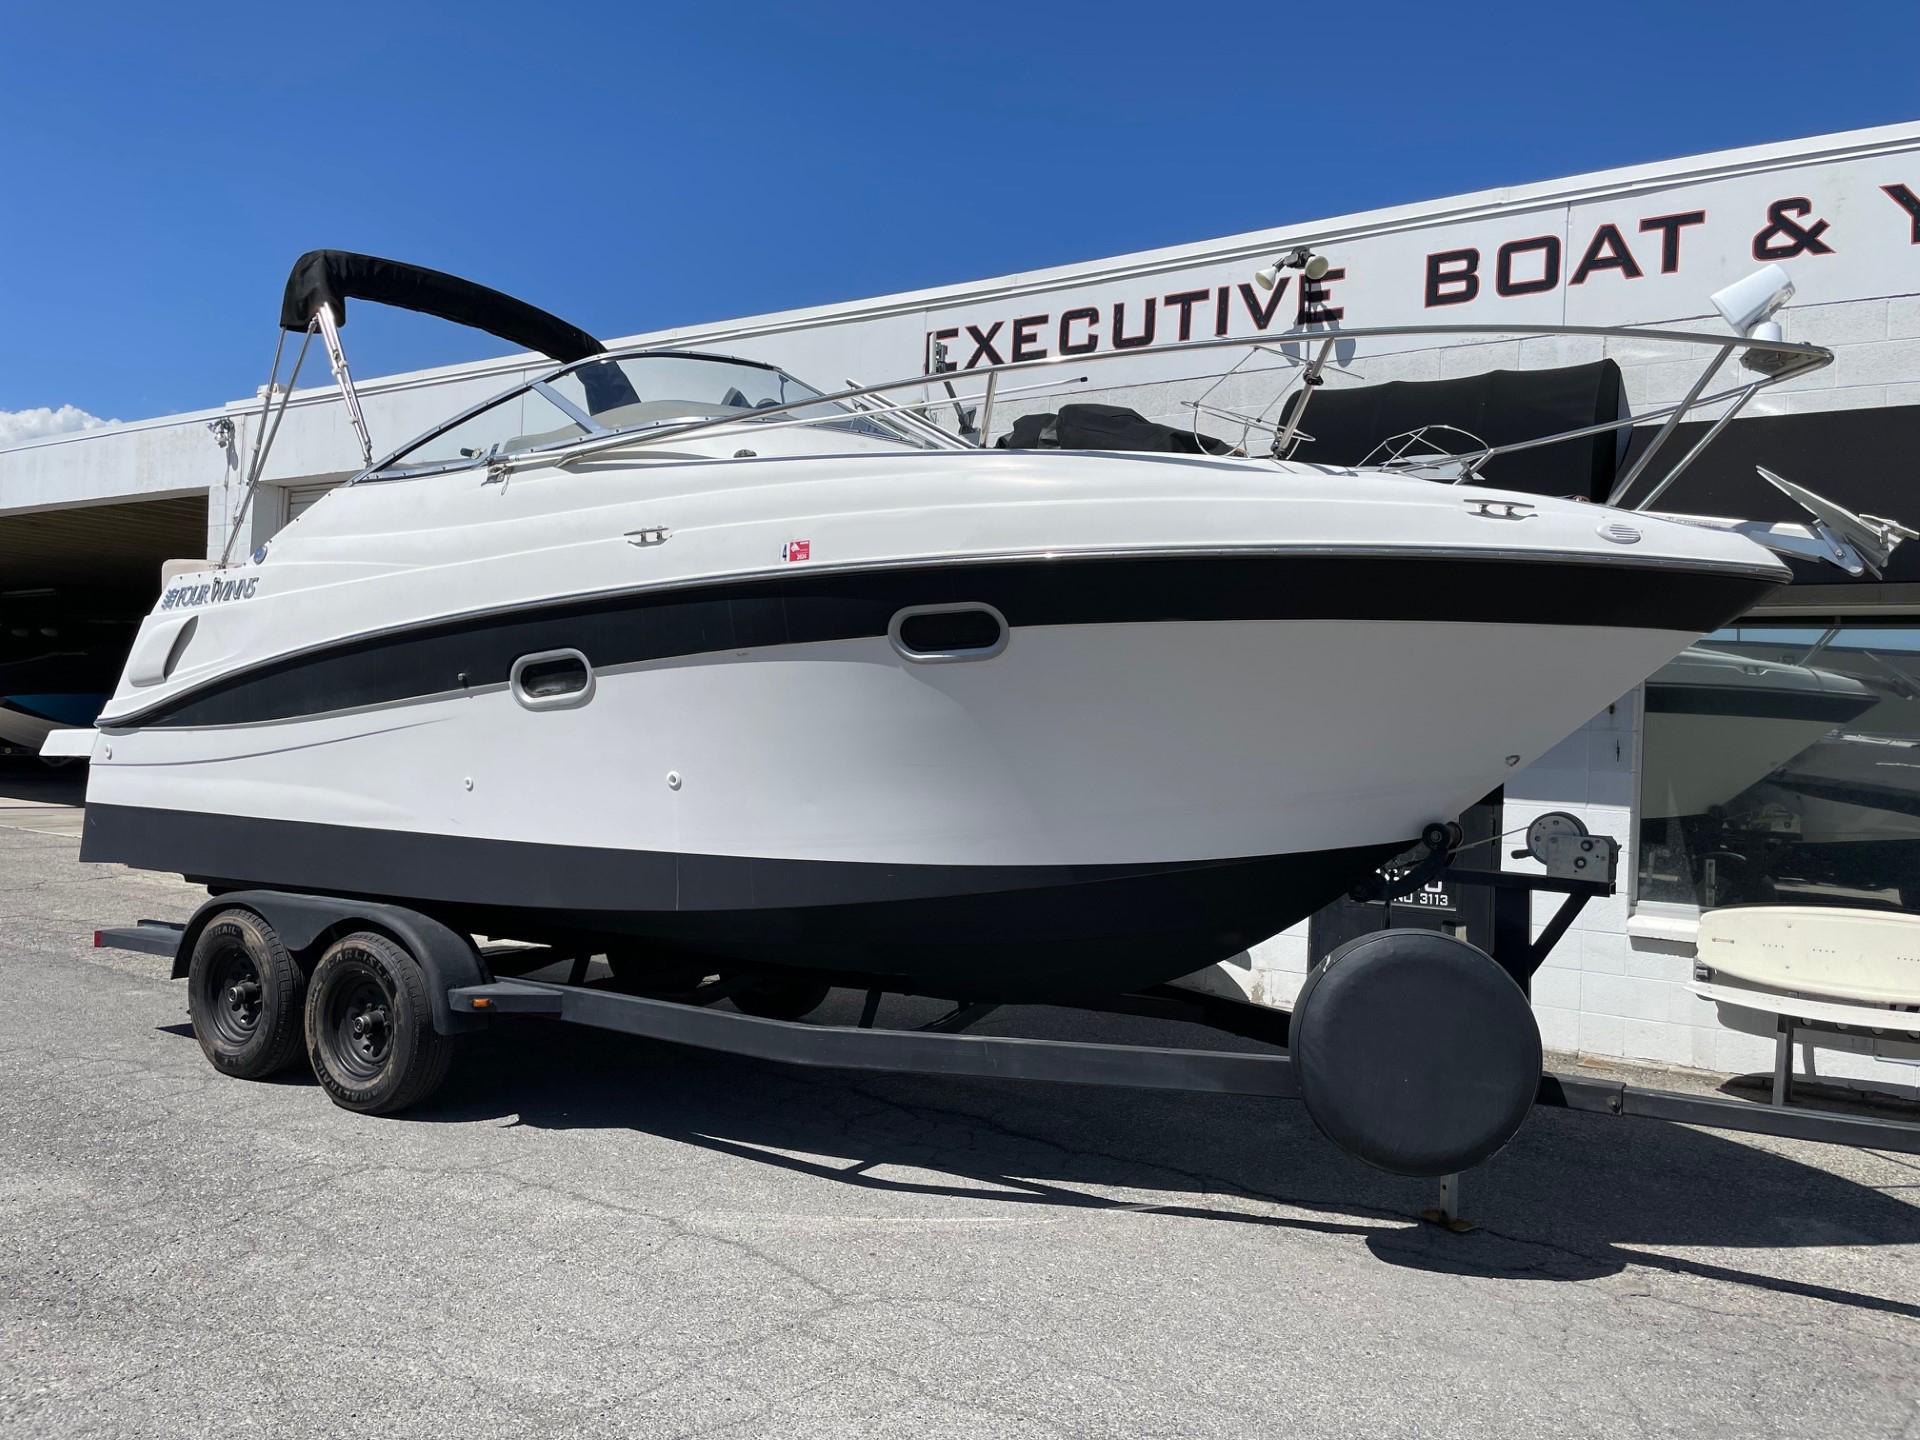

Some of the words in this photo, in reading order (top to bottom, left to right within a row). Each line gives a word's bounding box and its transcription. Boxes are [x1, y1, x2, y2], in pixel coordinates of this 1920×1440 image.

[925, 267, 1346, 374] EXECUTIVE
[1425, 209, 1705, 308] BOAT
[1752, 196, 1837, 262] &
[175, 584, 211, 607] FOUR
[1419, 893, 1448, 906] 3113
